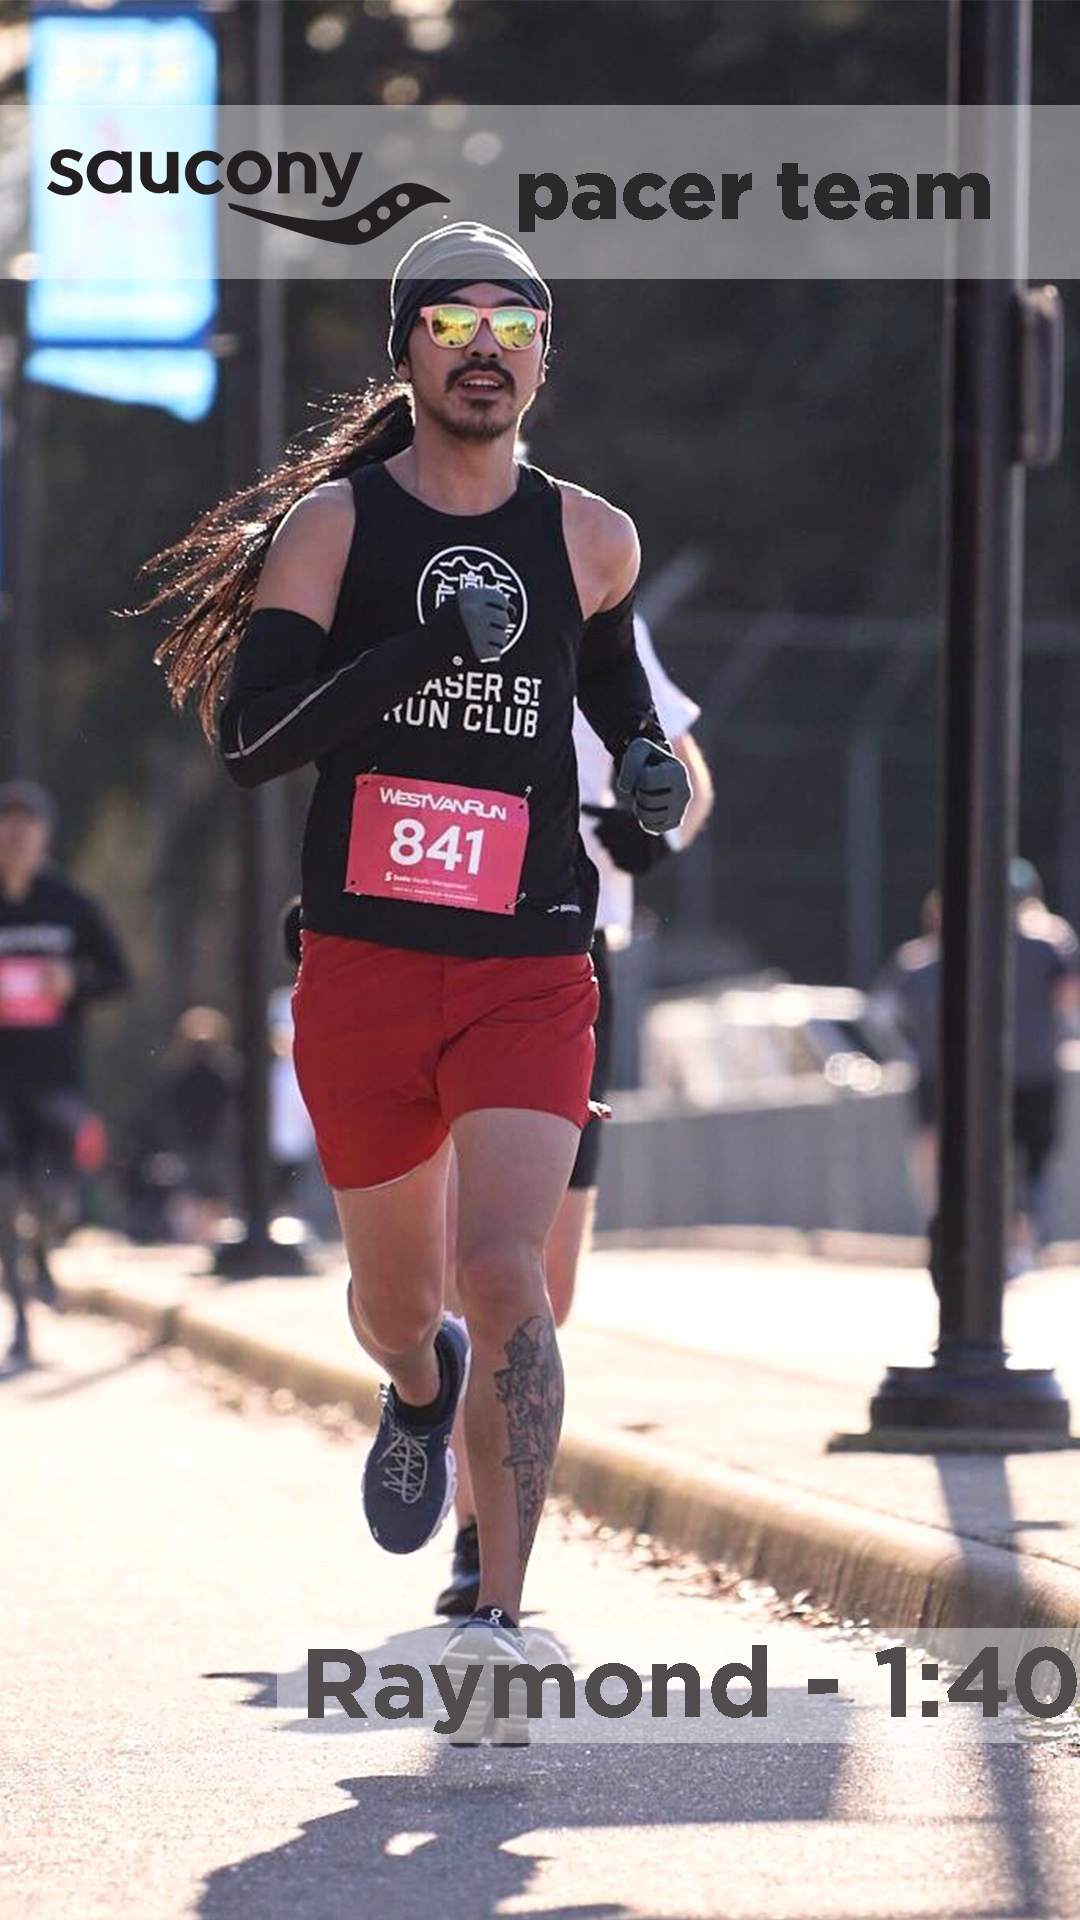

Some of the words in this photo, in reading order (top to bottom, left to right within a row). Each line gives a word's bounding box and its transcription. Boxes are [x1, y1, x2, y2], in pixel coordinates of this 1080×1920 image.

[417, 671, 502, 703] ASER
[463, 703, 538, 739] CLUB
[389, 817, 484, 875] 841
